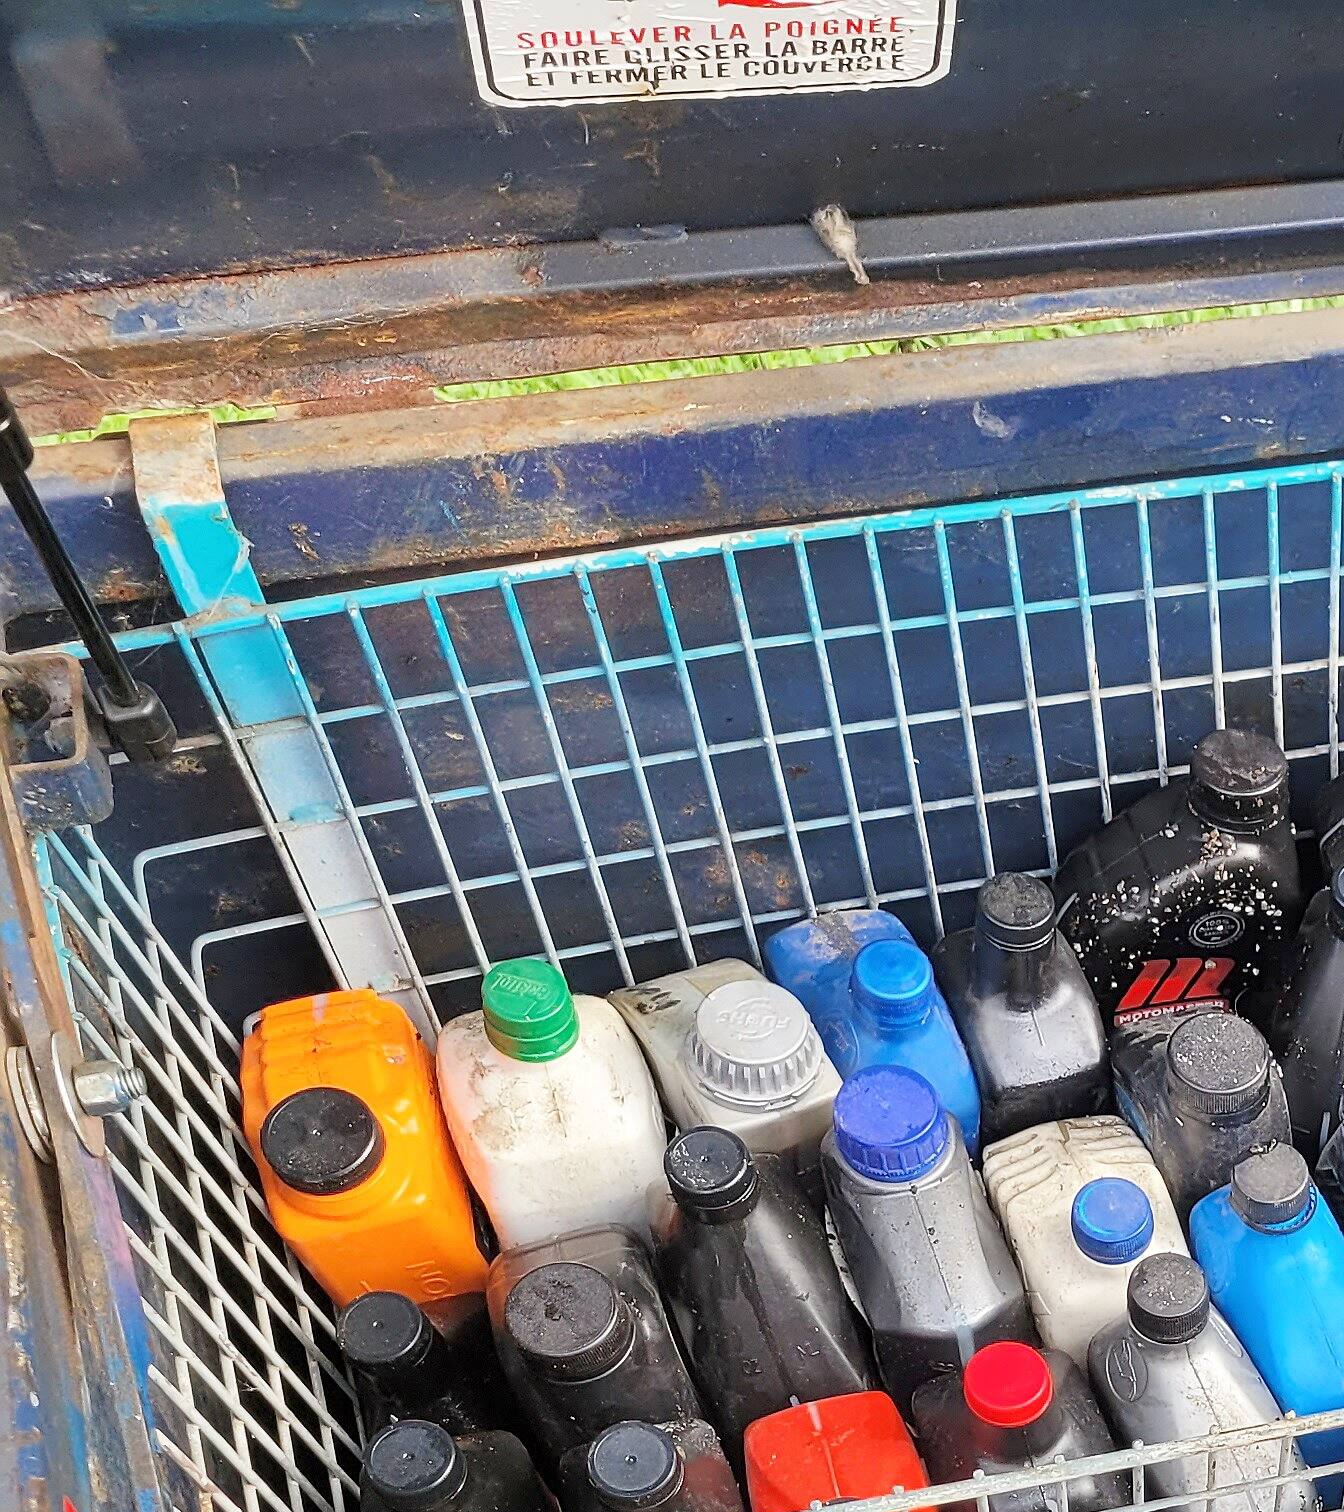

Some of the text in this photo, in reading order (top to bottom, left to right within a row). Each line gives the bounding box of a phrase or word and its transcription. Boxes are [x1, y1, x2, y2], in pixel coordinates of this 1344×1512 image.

[517, 24, 692, 50] SOULEVER
[710, 22, 747, 41] LA
[523, 35, 905, 70] FAIRE GLISSER LA BARRE
[527, 52, 906, 88] ET FERMER LE COUVERCLE
